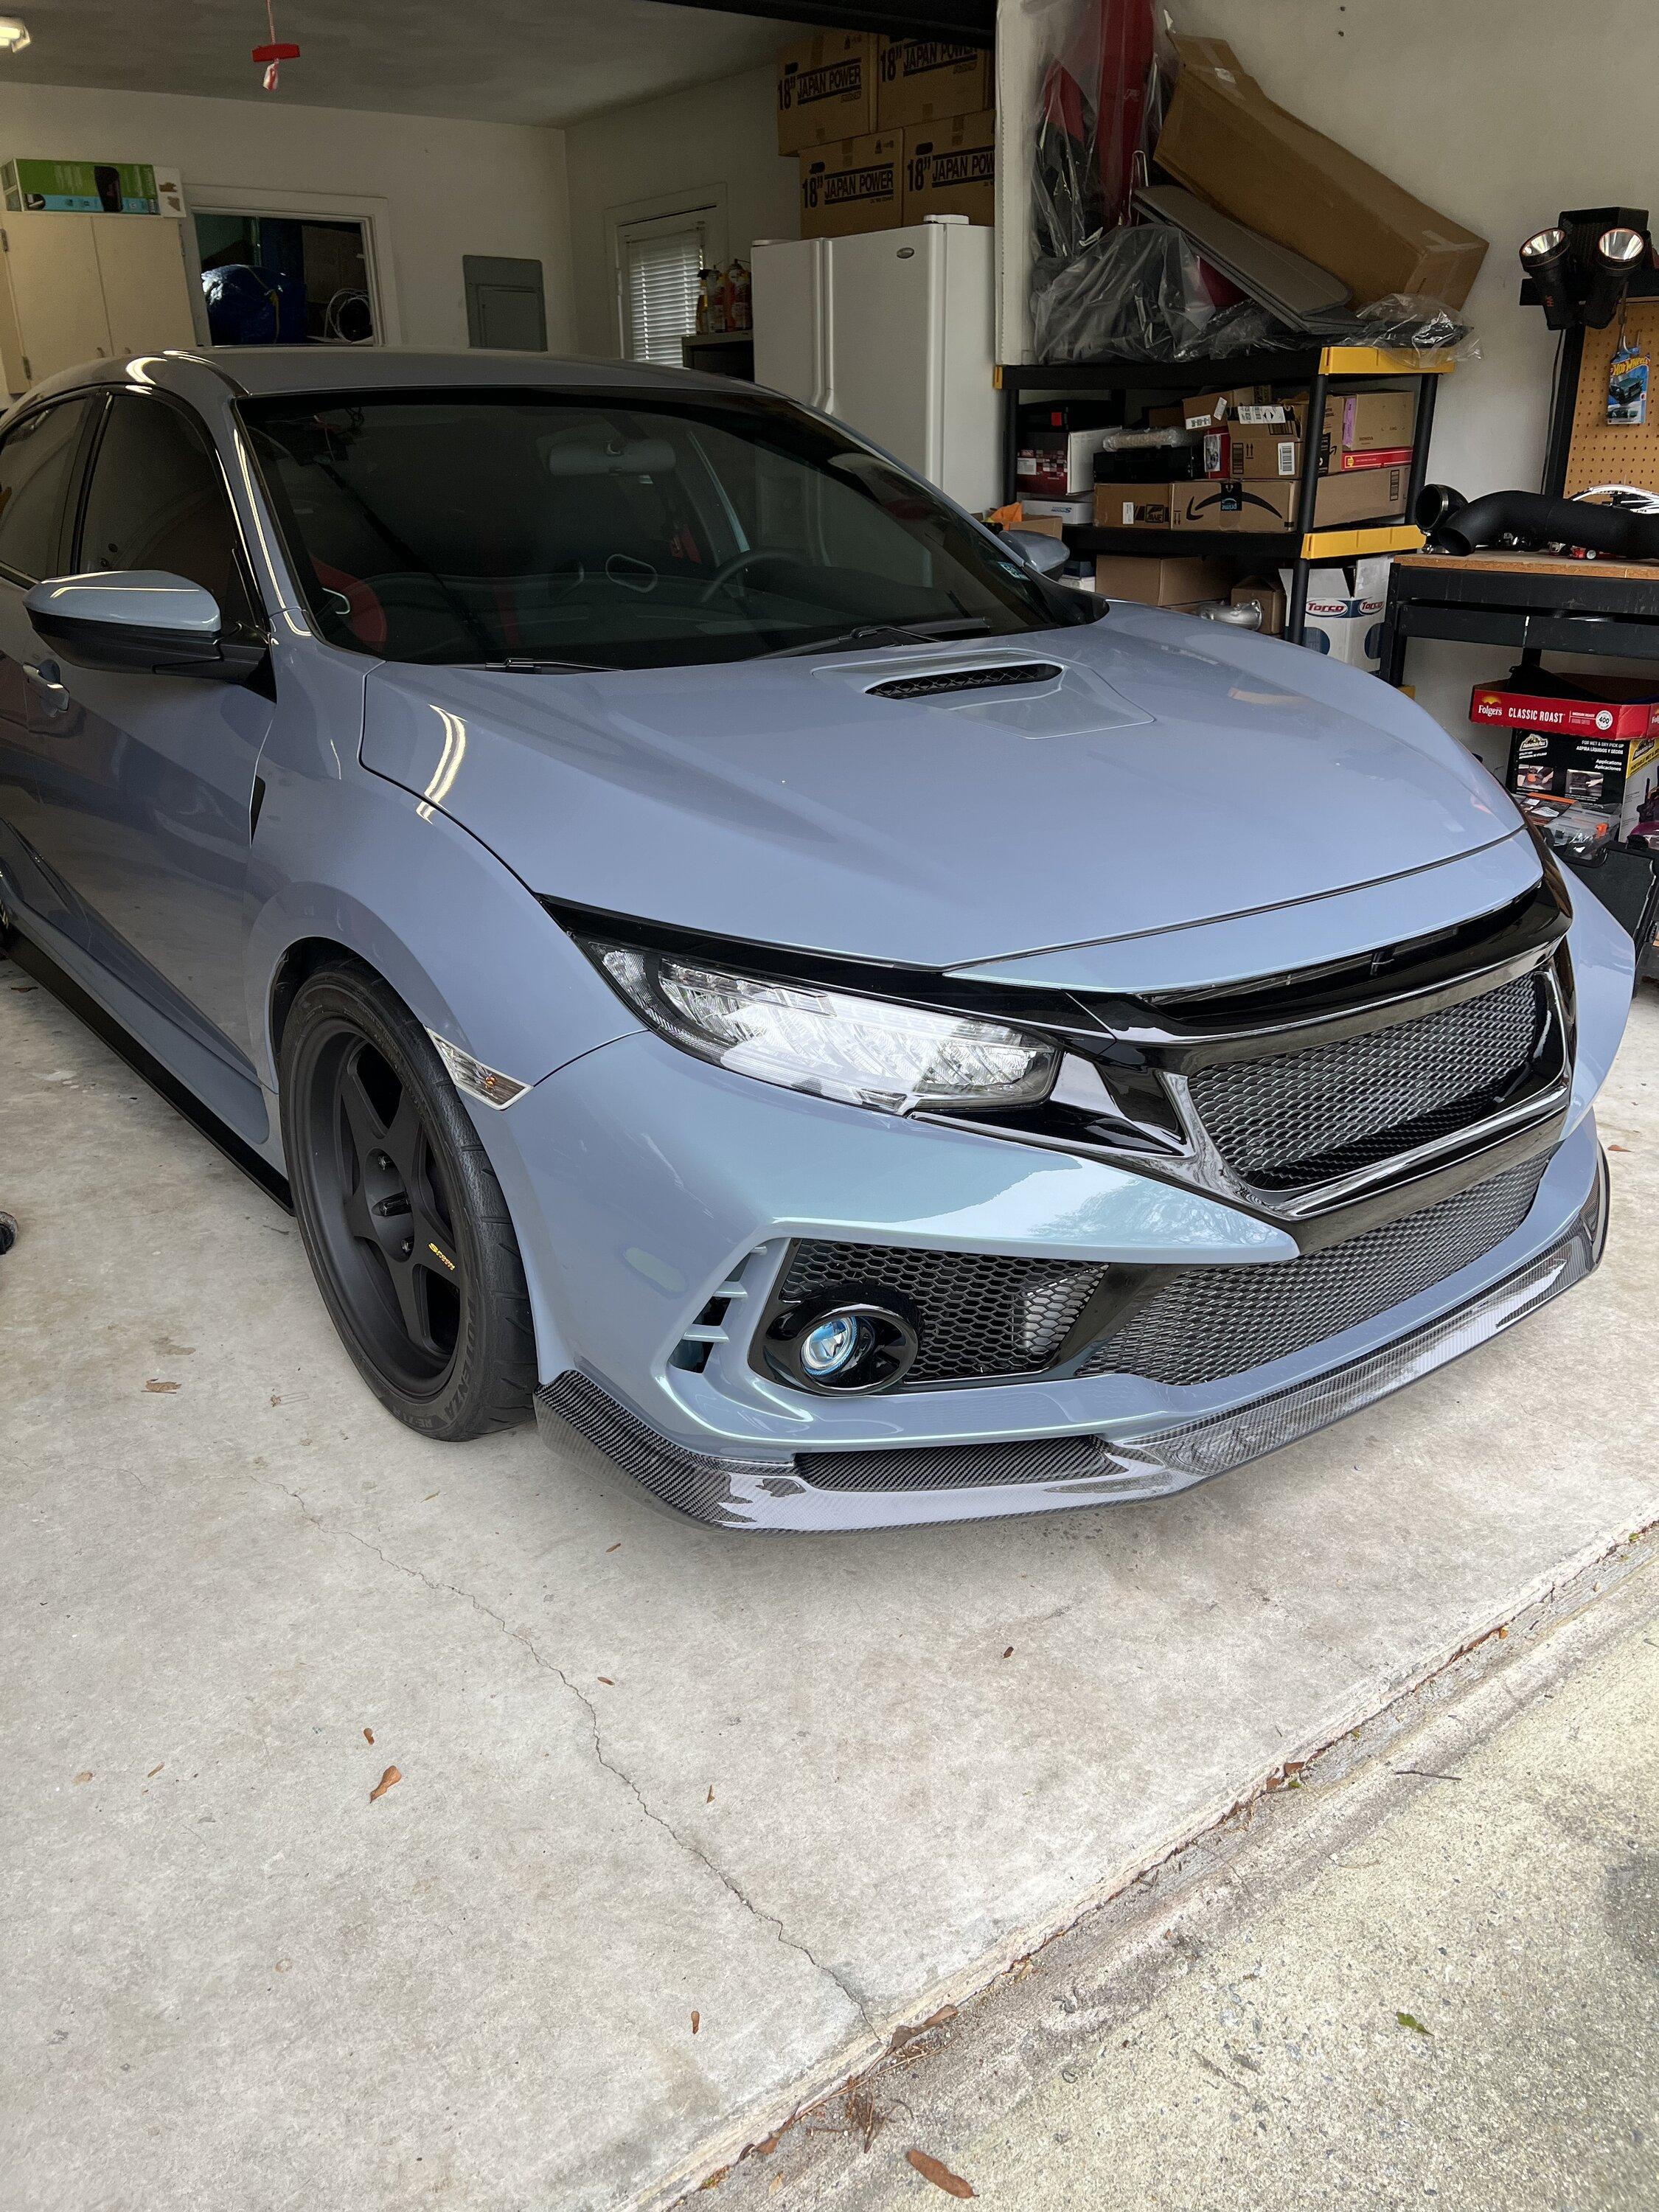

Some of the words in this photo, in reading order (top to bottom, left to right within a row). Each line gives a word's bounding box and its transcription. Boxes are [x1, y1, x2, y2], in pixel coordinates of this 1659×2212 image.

[903, 44, 938, 69] JAPAN
[798, 72, 826, 98] JAPAN
[829, 64, 861, 91] POWER
[932, 157, 967, 181] JAPAN
[972, 152, 995, 175] POW
[825, 176, 856, 199] JAPAN
[859, 170, 894, 192] POWER
[1613, 364, 1626, 376] HOT
[1625, 358, 1648, 372] WHEELS
[1308, 603, 1344, 613] Torco
[1362, 601, 1384, 611] Torco
[1478, 704, 1503, 717] Folgers
[1509, 707, 1537, 720] CLASSIC
[1539, 711, 1563, 723] ROAST
[1599, 716, 1610, 724] 400
